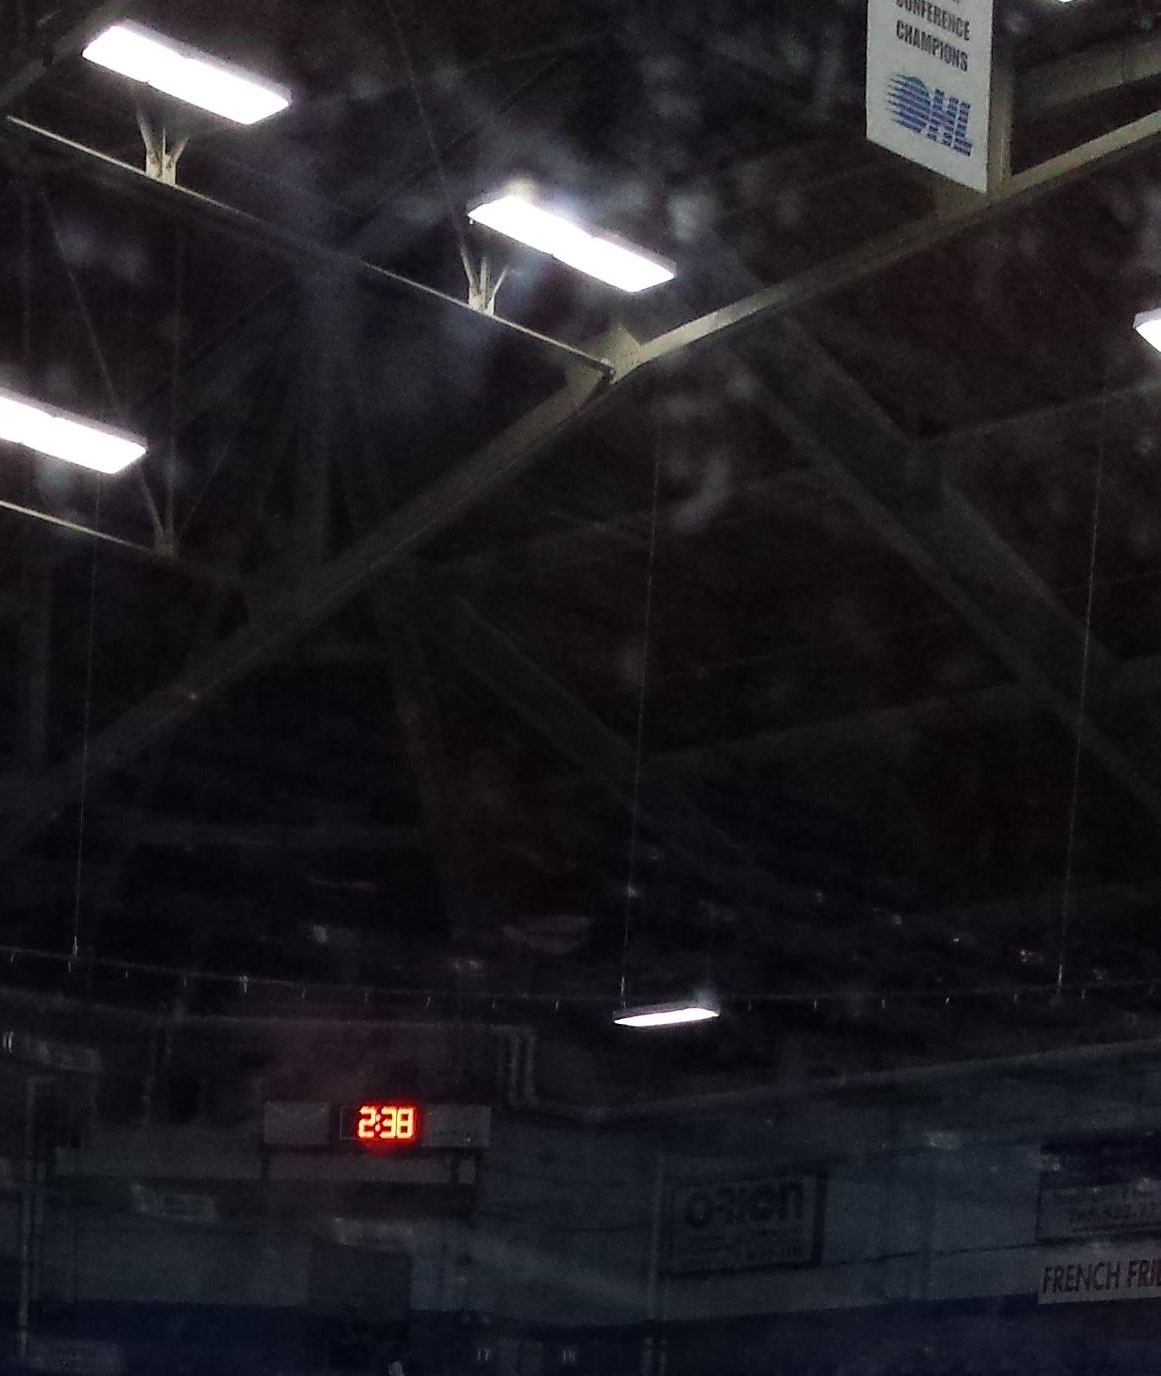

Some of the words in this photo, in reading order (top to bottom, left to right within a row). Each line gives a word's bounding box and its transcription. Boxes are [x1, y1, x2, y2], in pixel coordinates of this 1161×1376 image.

[896, 19, 968, 72] CHAMPIONS
[887, 73, 972, 157] OHL
[358, 1105, 415, 1139] 2:38
[1043, 1261, 1121, 1294] FRENCH
